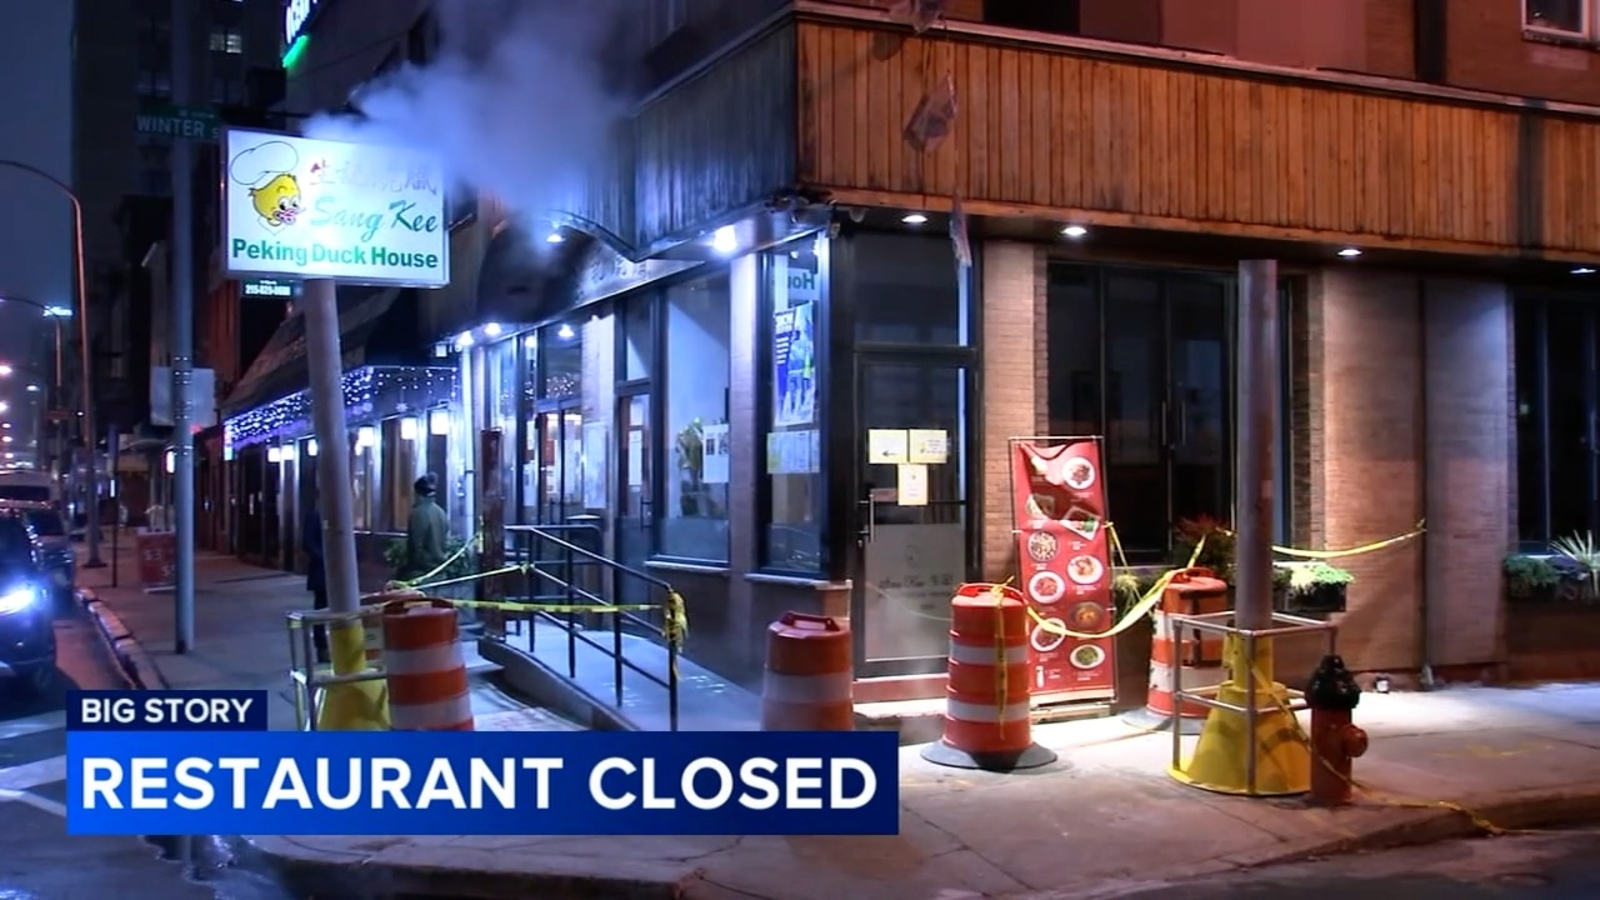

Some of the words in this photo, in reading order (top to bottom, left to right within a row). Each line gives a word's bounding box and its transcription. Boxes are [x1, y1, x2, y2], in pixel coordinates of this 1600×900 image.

[136, 115, 205, 137] WINTER
[309, 195, 384, 243] Sang
[388, 199, 438, 232] Kee
[232, 238, 307, 266] Peking
[311, 243, 366, 265] Duck
[370, 246, 438, 268] House
